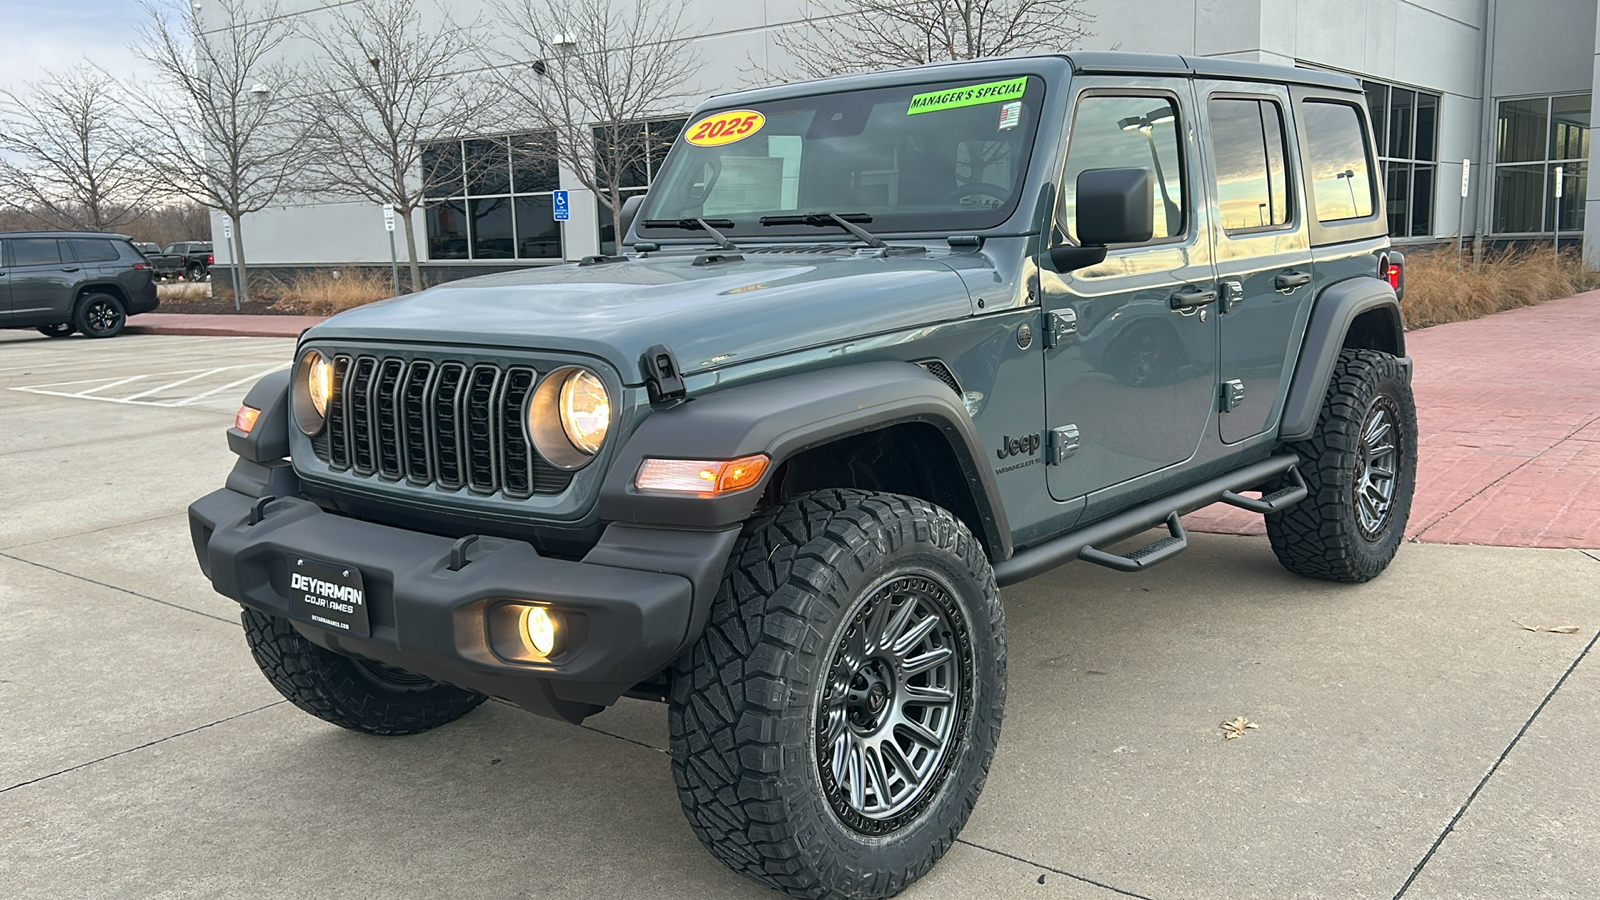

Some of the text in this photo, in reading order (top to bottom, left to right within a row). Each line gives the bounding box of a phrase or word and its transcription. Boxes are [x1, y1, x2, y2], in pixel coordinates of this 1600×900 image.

[911, 83, 1023, 109] MANAGER'S SPECIAL
[691, 115, 758, 140] 2025
[997, 432, 1040, 459] Jeep
[995, 459, 1035, 475] WRANGLER
[291, 572, 362, 605] DEYARMAN
[329, 601, 354, 614] AMES
